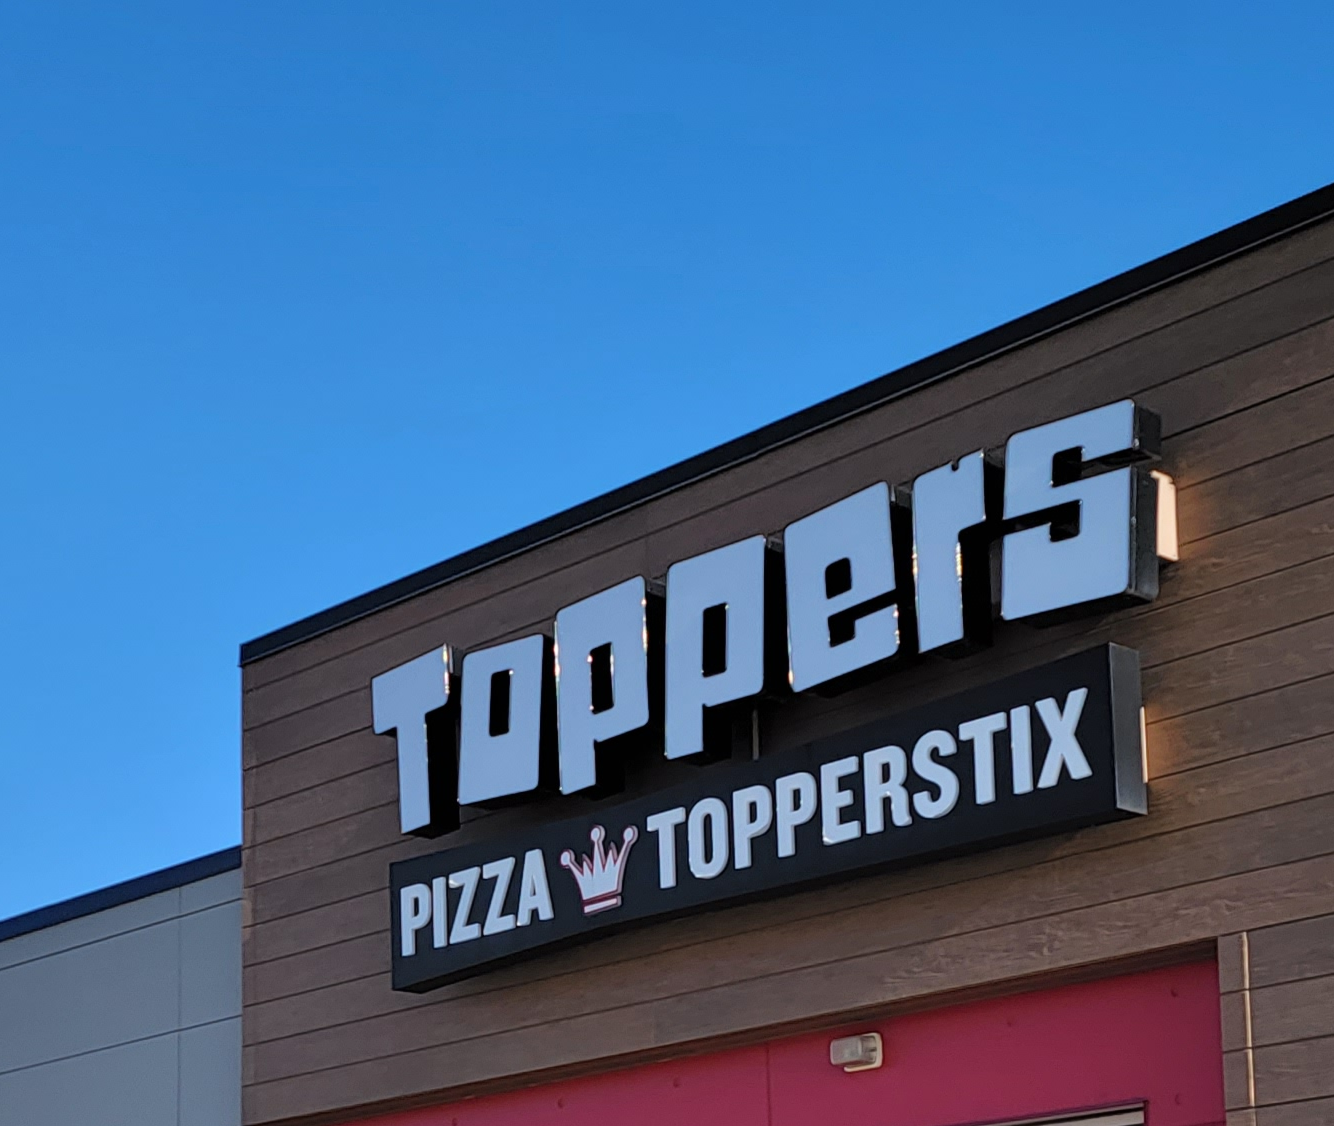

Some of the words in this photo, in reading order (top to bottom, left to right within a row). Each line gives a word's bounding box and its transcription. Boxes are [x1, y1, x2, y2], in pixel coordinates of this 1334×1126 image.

[371, 399, 1135, 835] Toppers
[400, 848, 556, 957] PIZZA
[646, 687, 1093, 890] TOPPERSTIX
